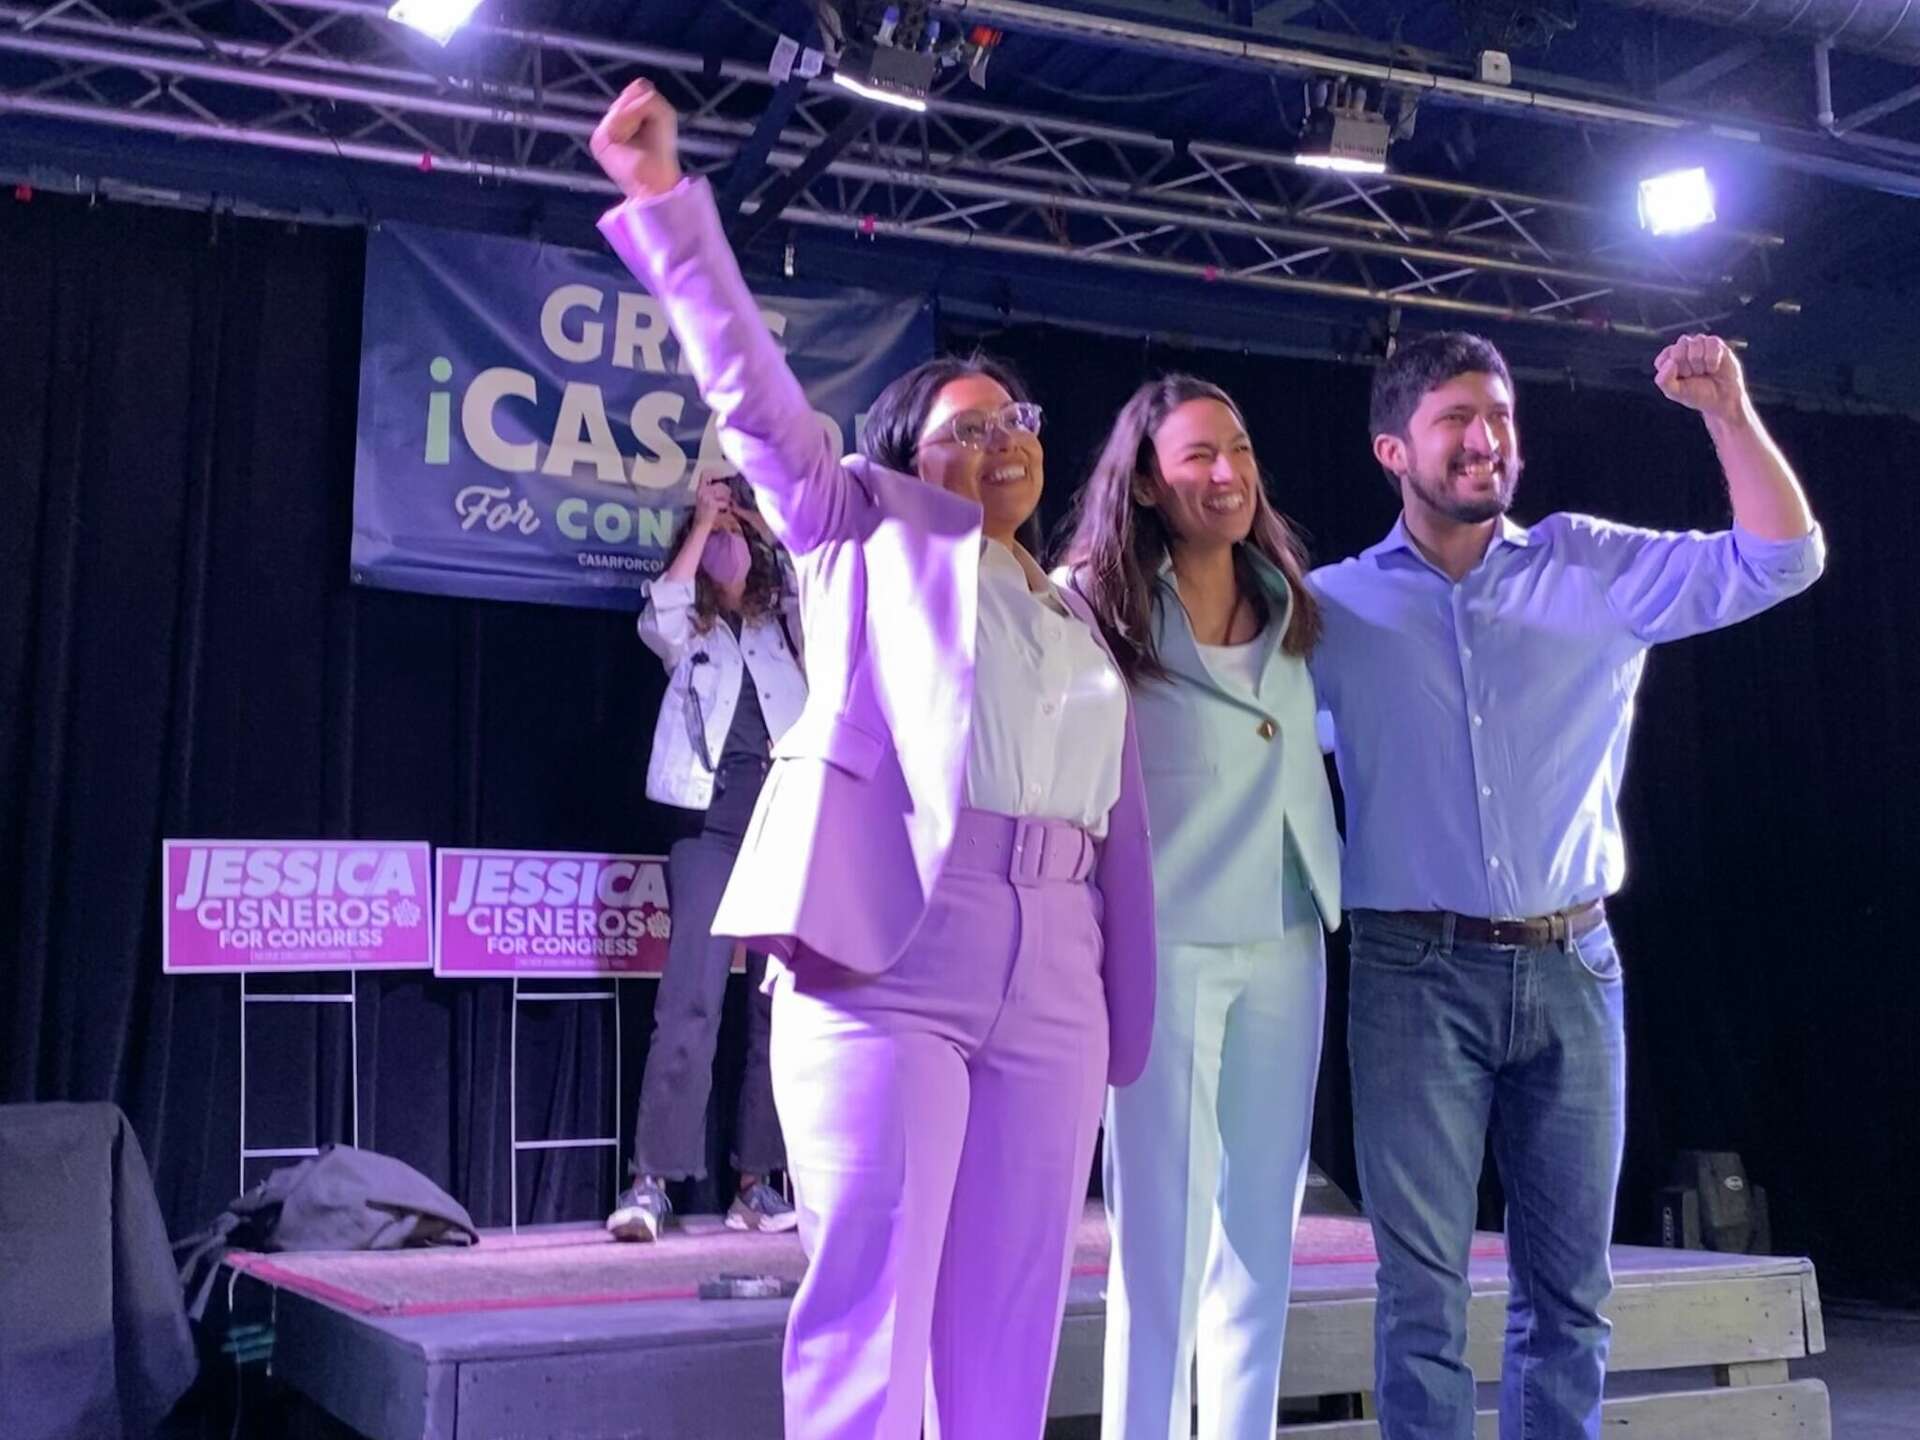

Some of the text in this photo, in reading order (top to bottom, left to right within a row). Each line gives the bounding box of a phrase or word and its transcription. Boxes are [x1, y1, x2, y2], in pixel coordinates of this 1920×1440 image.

[540, 284, 787, 377] GR
[455, 485, 541, 535] For
[176, 848, 415, 911] JESSICA
[448, 858, 669, 915] JESSICA
[197, 899, 390, 930] CISNEROS
[466, 907, 646, 937] CISNEROS
[219, 928, 383, 949] FOR CONGRESS
[486, 936, 638, 956] FOR CONGRESS
